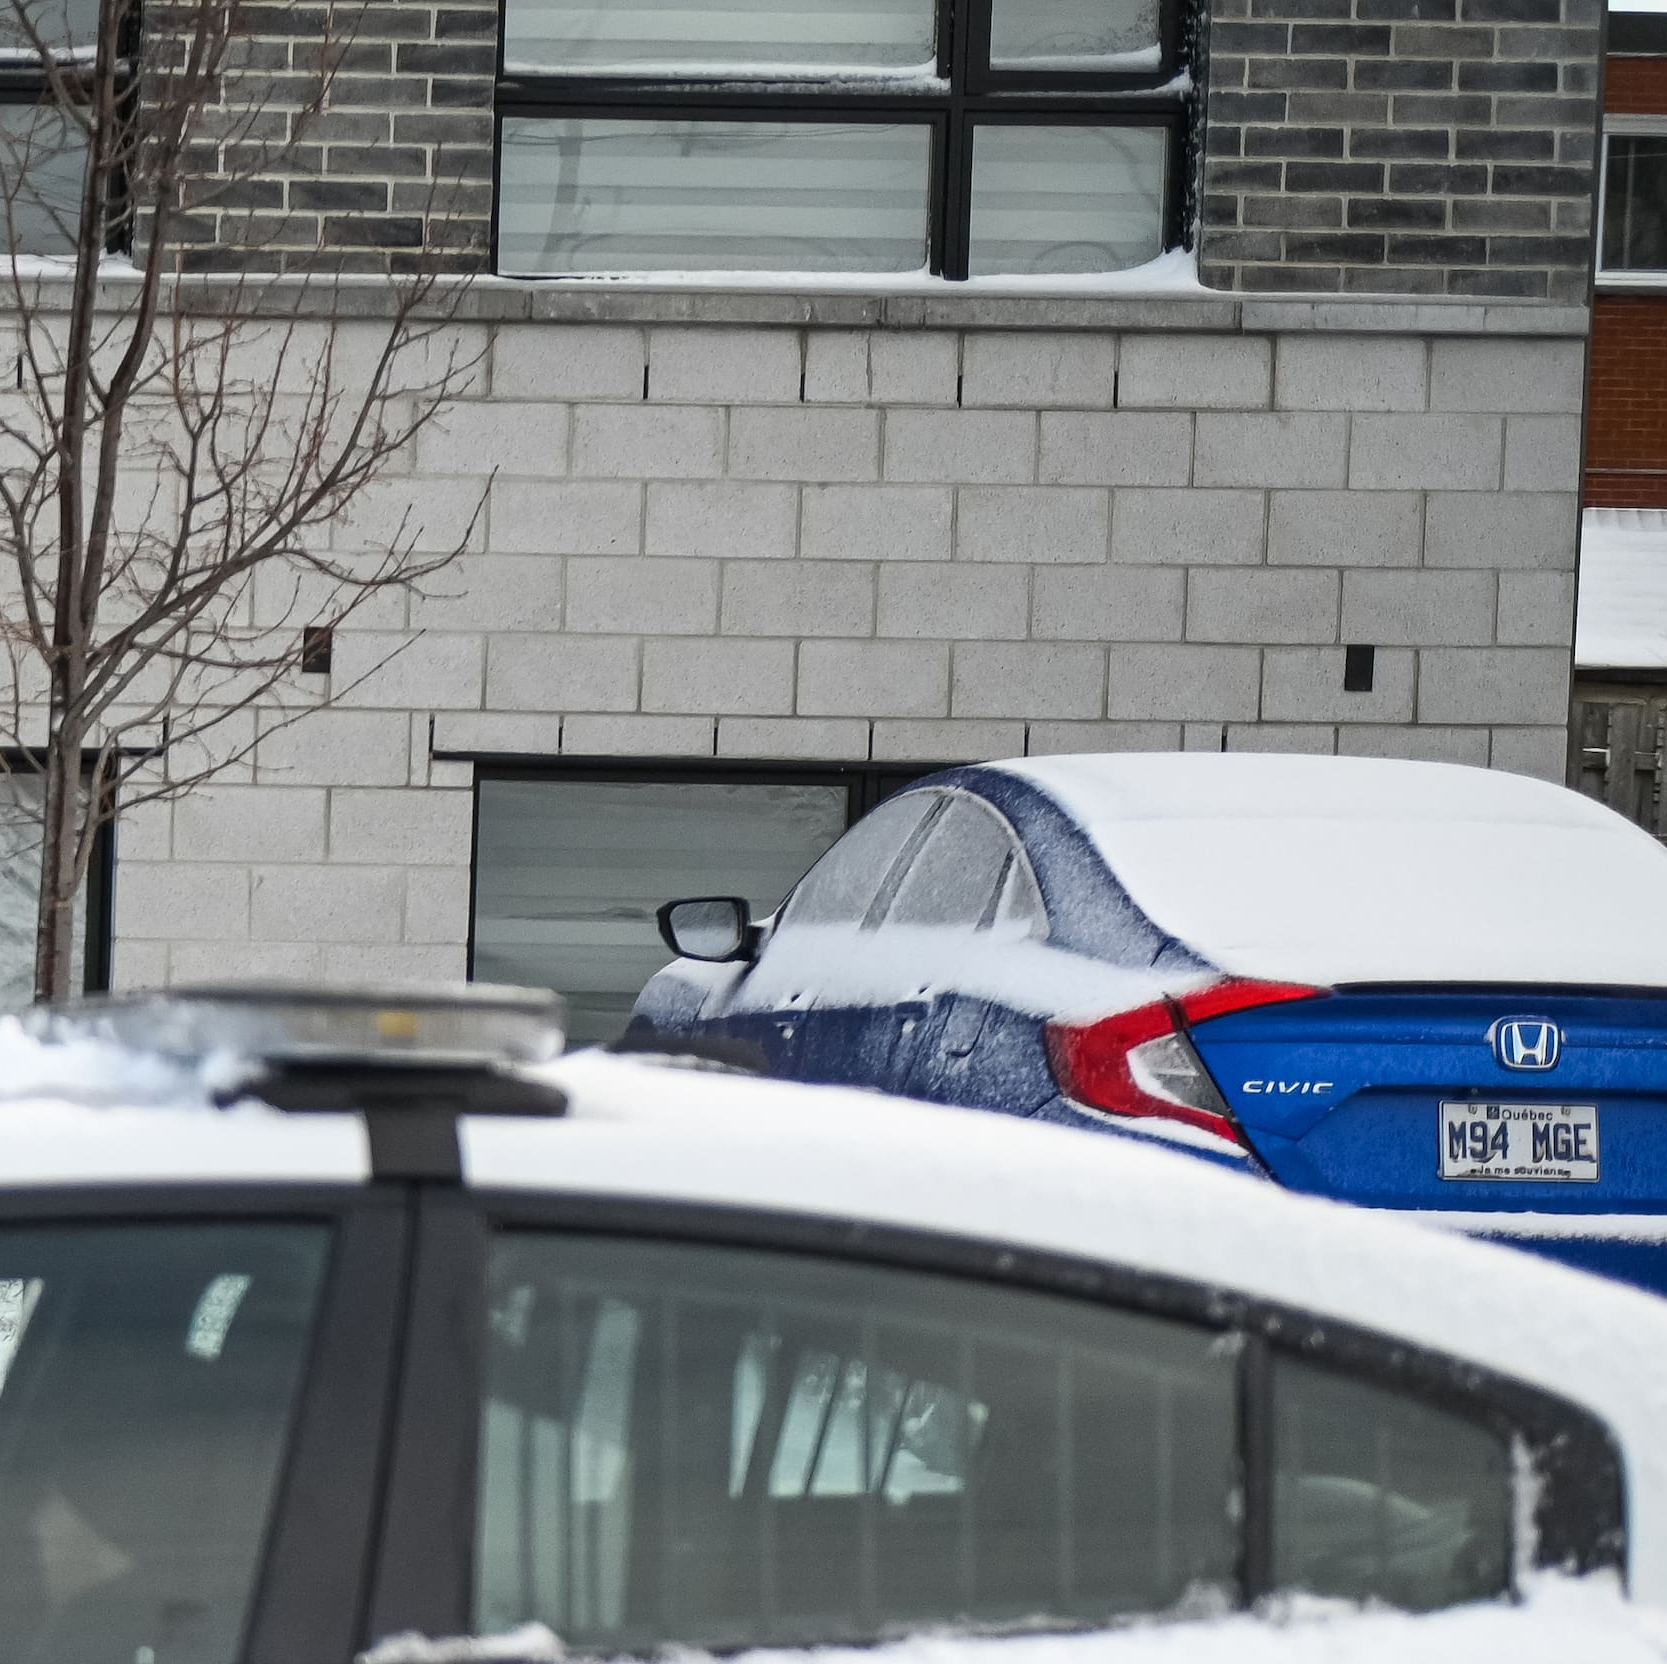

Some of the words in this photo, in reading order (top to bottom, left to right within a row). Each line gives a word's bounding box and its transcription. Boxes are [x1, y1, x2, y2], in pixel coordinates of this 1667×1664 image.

[1242, 1080, 1334, 1094] CIVIC
[1501, 1108, 1554, 1122] Québec
[1448, 1120, 1510, 1161] M94
[1532, 1122, 1596, 1163] MGE
